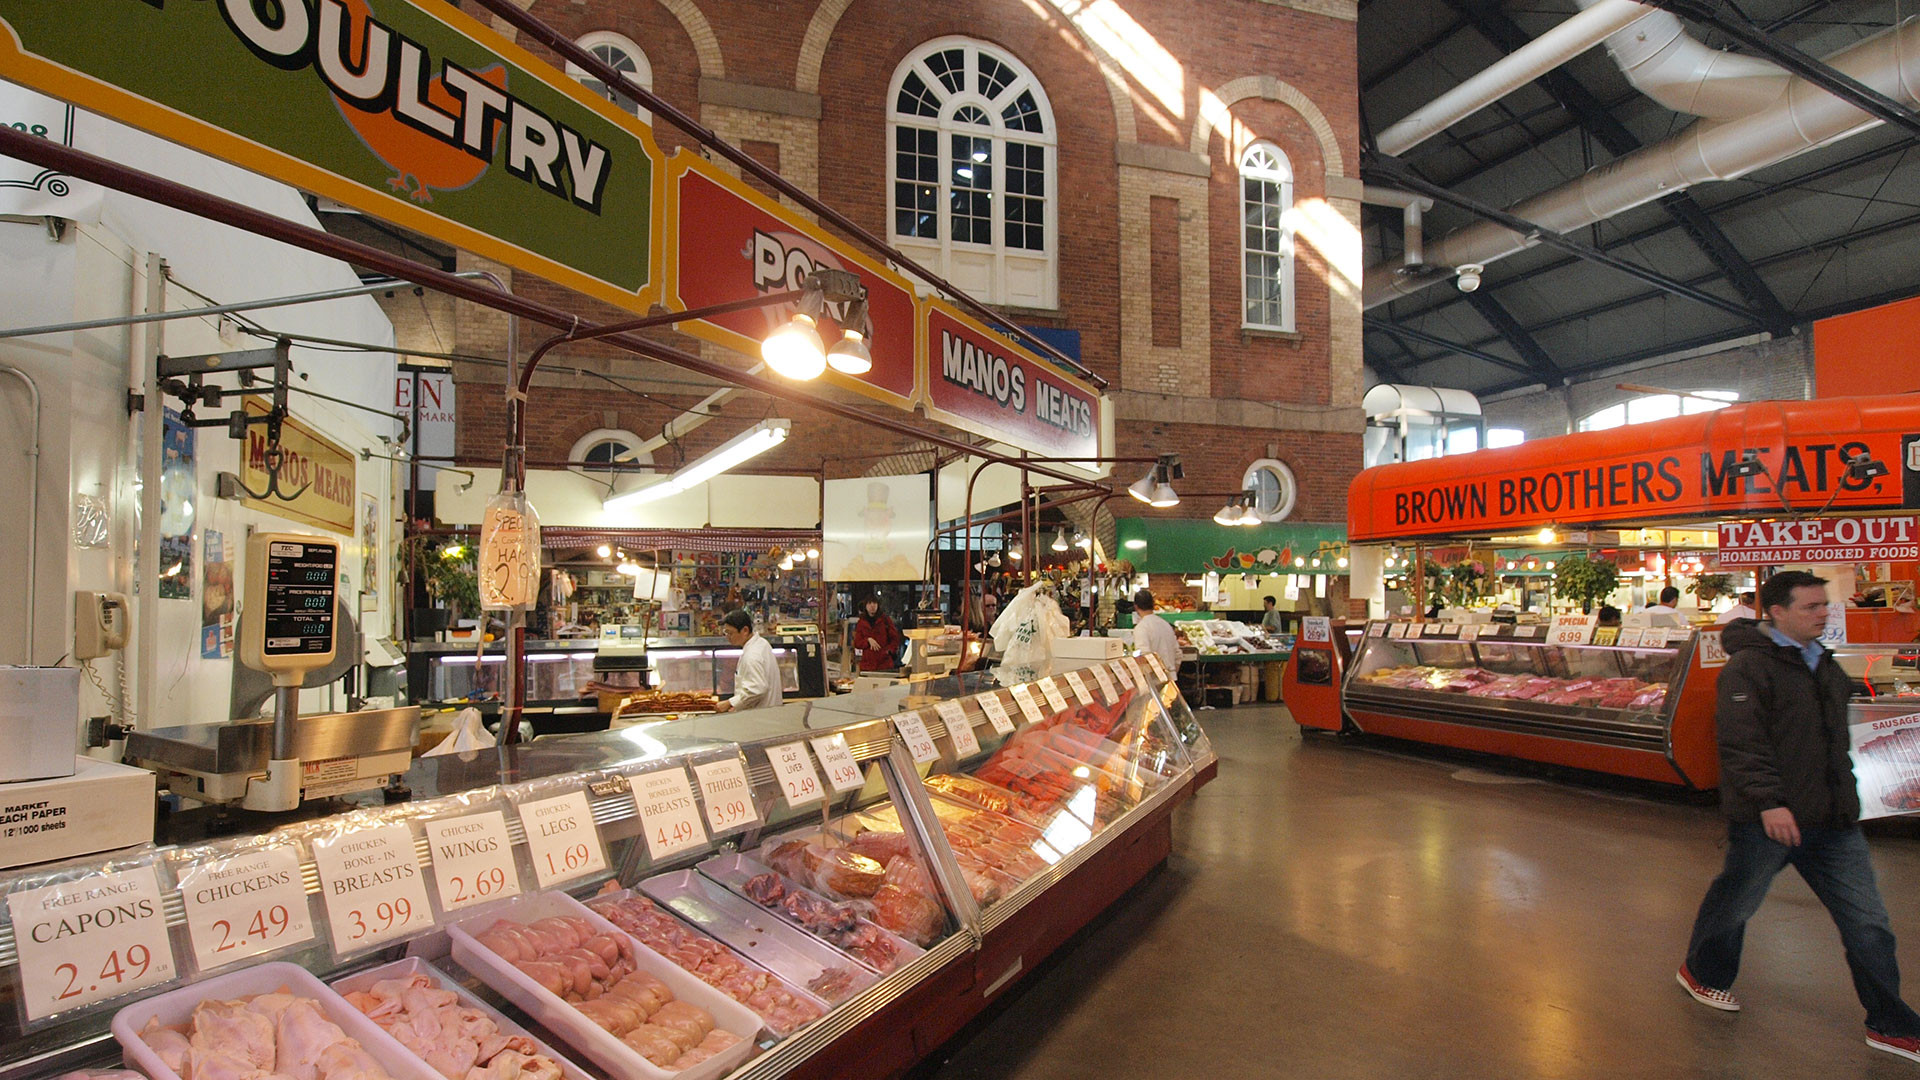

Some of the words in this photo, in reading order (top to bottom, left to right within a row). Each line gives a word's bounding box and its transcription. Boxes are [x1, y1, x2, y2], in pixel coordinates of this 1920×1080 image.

[218, 0, 612, 216] OULTRY
[753, 227, 868, 338] PO
[942, 329, 1025, 413] MANOS
[1035, 378, 1091, 438] MEATS
[420, 411, 455, 422] MARK
[313, 462, 352, 507] MEATS
[1395, 482, 1487, 525] BROWN
[1500, 456, 1683, 516] BROTHERS
[1700, 441, 1882, 497] MEATS,
[495, 510, 533, 531] SPECL
[1721, 516, 1914, 547] TAKE-OUT
[498, 547, 528, 562] HAM
[1720, 548, 1801, 562] HOMEMADE
[1806, 548, 1864, 560] COOKED
[1869, 546, 1919, 559] FOODS
[1558, 617, 1589, 626] SPECIAL
[1872, 715, 1920, 730] SAUSAGE
[781, 752, 797, 763] CALF
[825, 751, 848, 763] SHANKS
[913, 741, 932, 758] 2.99
[707, 766, 732, 777] CHICKEN
[785, 762, 804, 775] LIVER
[834, 765, 857, 783] 4.99
[645, 777, 672, 789] CHICKEN
[648, 786, 681, 800] BONELESS
[705, 776, 744, 794] THIGHS
[788, 777, 815, 798] 2.49
[5, 801, 49, 813] MARKET
[31, 807, 67, 820] PAPER
[535, 803, 571, 818] CHICKEN
[643, 796, 691, 817] BREASTS
[713, 800, 746, 825] 3.99
[41, 819, 66, 832] sheets
[440, 823, 484, 838] CHICKEN
[540, 816, 577, 838] LEGS
[656, 820, 692, 847] 4.49
[341, 837, 388, 855] CHICKEN
[440, 836, 499, 861] WINGS
[343, 854, 376, 870] BONE
[545, 843, 590, 876] 1.69
[208, 868, 234, 881] FREE
[236, 861, 271, 875] RANGE
[333, 863, 414, 896] BREASTS
[196, 870, 290, 905] CHICKENS
[450, 867, 505, 903] 2.69
[42, 893, 82, 911] FREE
[85, 880, 139, 901] RANGE
[31, 899, 154, 944] CAPONS
[347, 897, 412, 939] 3.99
[211, 904, 289, 953] 2.49
[54, 944, 151, 1001] 2.49
